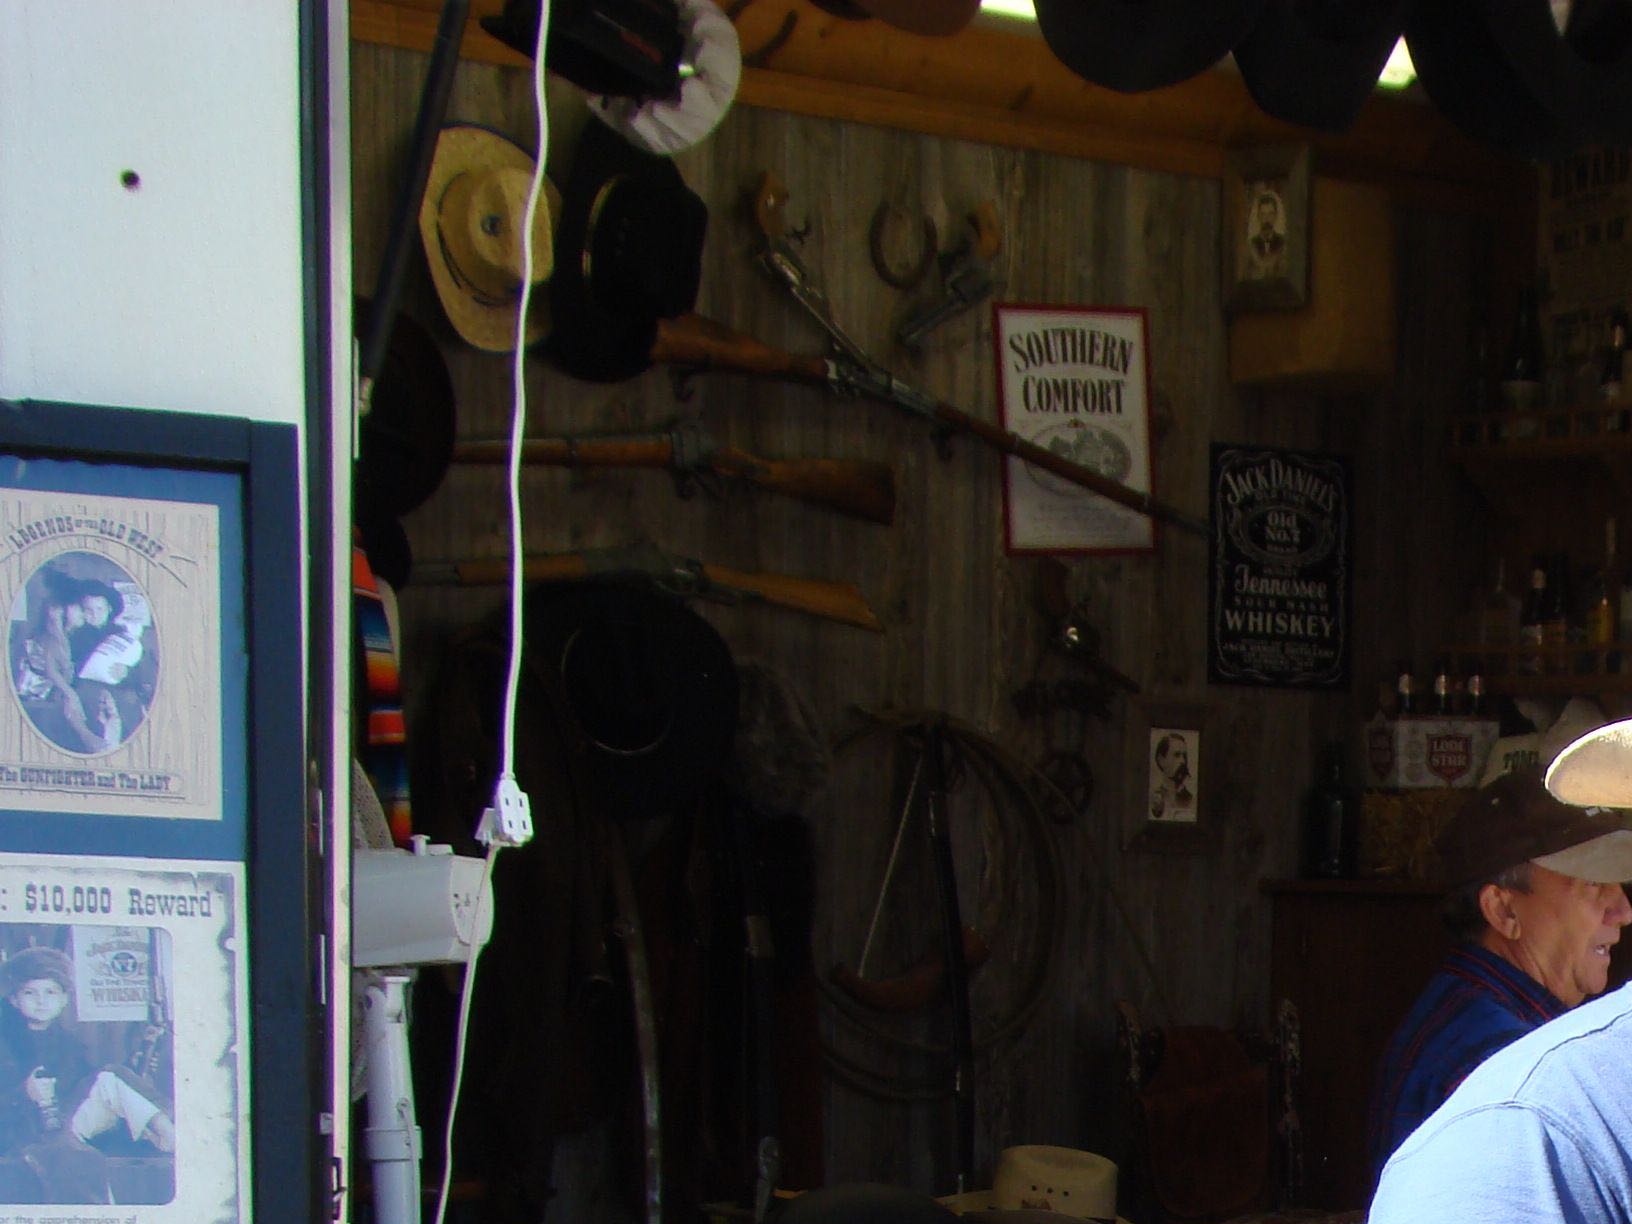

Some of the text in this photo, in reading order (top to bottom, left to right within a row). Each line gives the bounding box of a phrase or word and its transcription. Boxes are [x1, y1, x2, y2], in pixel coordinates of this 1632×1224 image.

[1009, 328, 1133, 374] SOUTHERN
[1023, 375, 1125, 415] COMFORT
[1225, 466, 1269, 505] JACK
[1266, 510, 1298, 527] Old
[9, 516, 75, 549] LEGENDS
[99, 518, 126, 539] OLD
[128, 528, 165, 558] WEST
[1235, 564, 1327, 600] Tennessee
[1225, 609, 1336, 639] WHISKEY
[140, 774, 171, 790] LADY
[25, 882, 211, 917] $10,000 Reward
[15, 1216, 34, 1224] the
[124, 1215, 137, 1224] of
